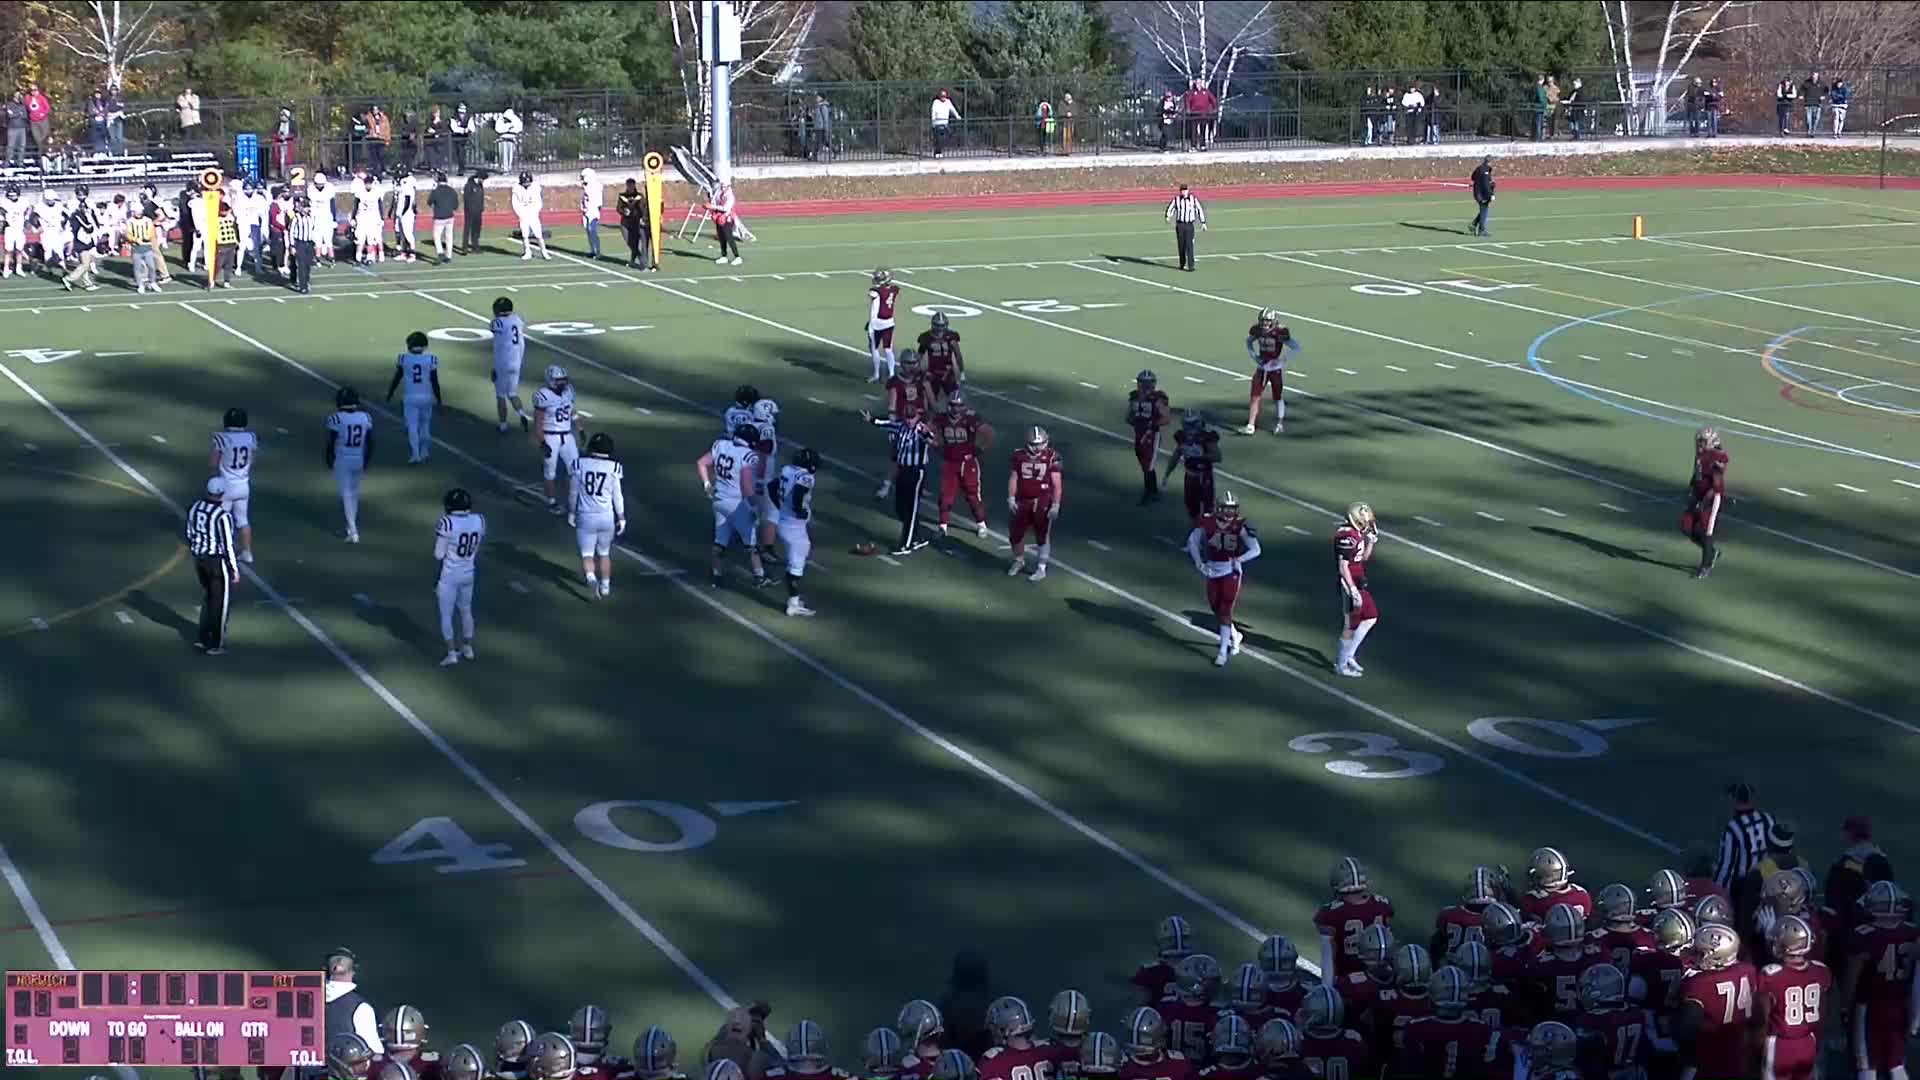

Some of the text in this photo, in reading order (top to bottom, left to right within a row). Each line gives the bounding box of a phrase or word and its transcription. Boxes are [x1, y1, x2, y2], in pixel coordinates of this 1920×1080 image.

[290, 167, 305, 186] 2
[511, 325, 520, 345] 3
[413, 363, 423, 384] 2
[345, 424, 362, 447] 12
[231, 446, 248, 470] 13
[715, 453, 734, 480] 62
[1020, 461, 1048, 482] 57
[584, 470, 608, 497] 87
[457, 531, 480, 558] 80
[1287, 716, 1609, 779] 30
[370, 799, 718, 873] 40
[1715, 975, 1753, 1025] 74
[1784, 982, 1821, 1026] 89
